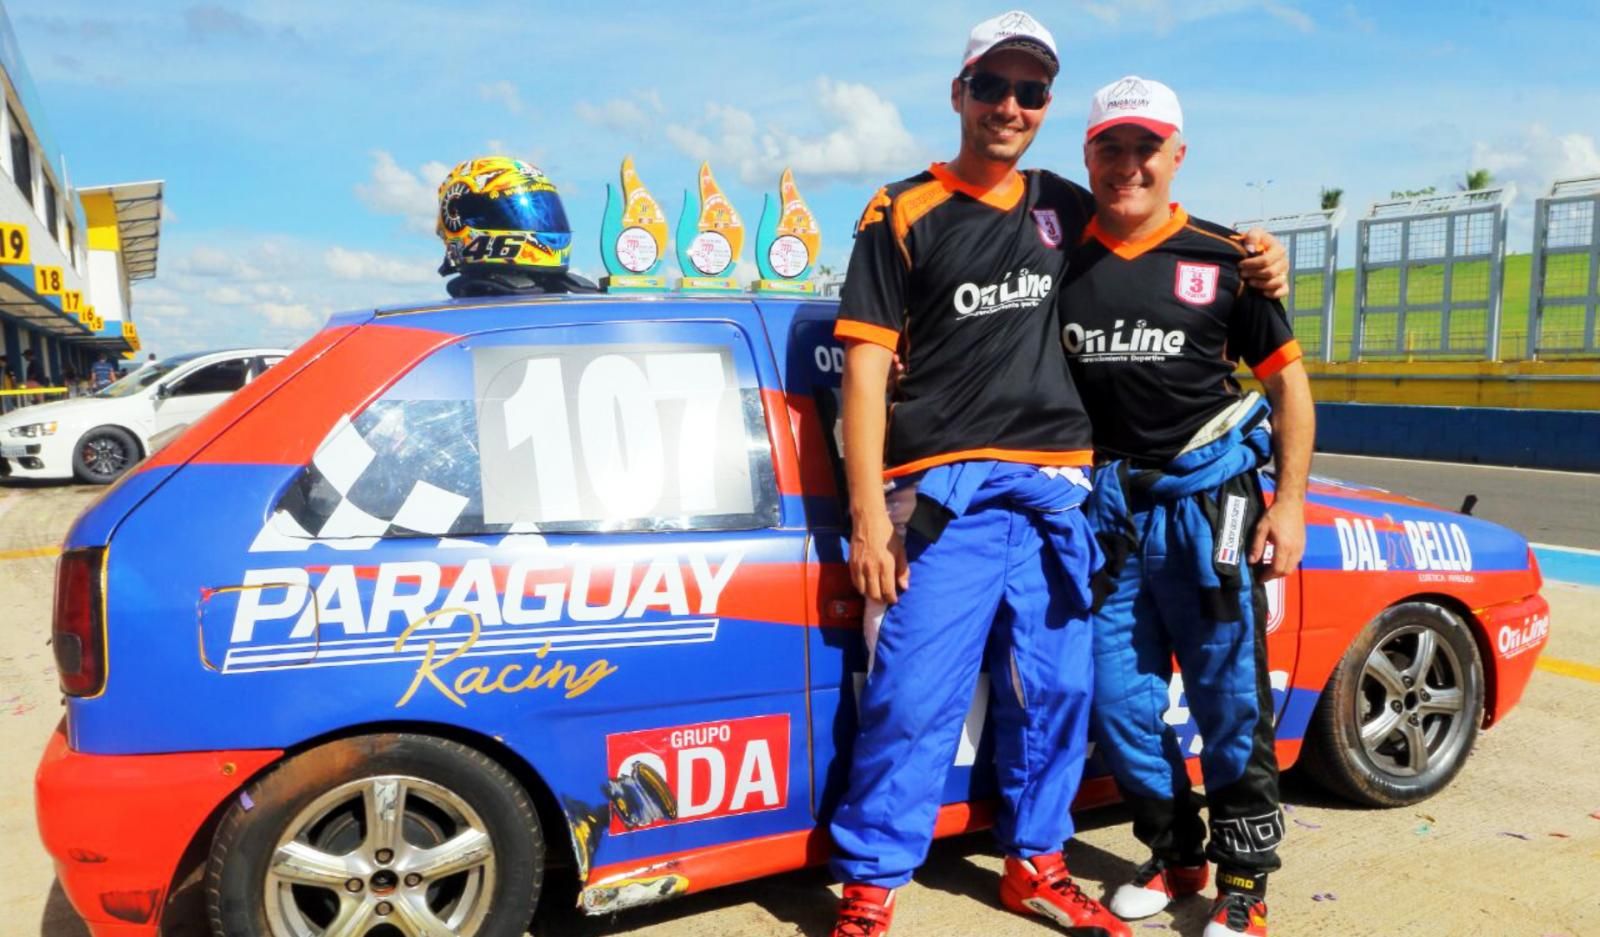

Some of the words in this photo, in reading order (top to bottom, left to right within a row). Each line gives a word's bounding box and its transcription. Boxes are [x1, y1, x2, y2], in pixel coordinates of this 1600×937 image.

[0, 228, 24, 259] 19
[462, 234, 527, 259] 46
[40, 269, 60, 291] 18
[1189, 278, 1204, 293] 3
[66, 292, 79, 310] 17
[82, 308, 94, 321] 16
[504, 352, 728, 523] 107
[1334, 517, 1388, 571] DAL
[1402, 520, 1473, 572] BELLO
[230, 550, 744, 642] PARAGUAY
[394, 607, 618, 708] Racing
[671, 724, 731, 748] GRUPO
